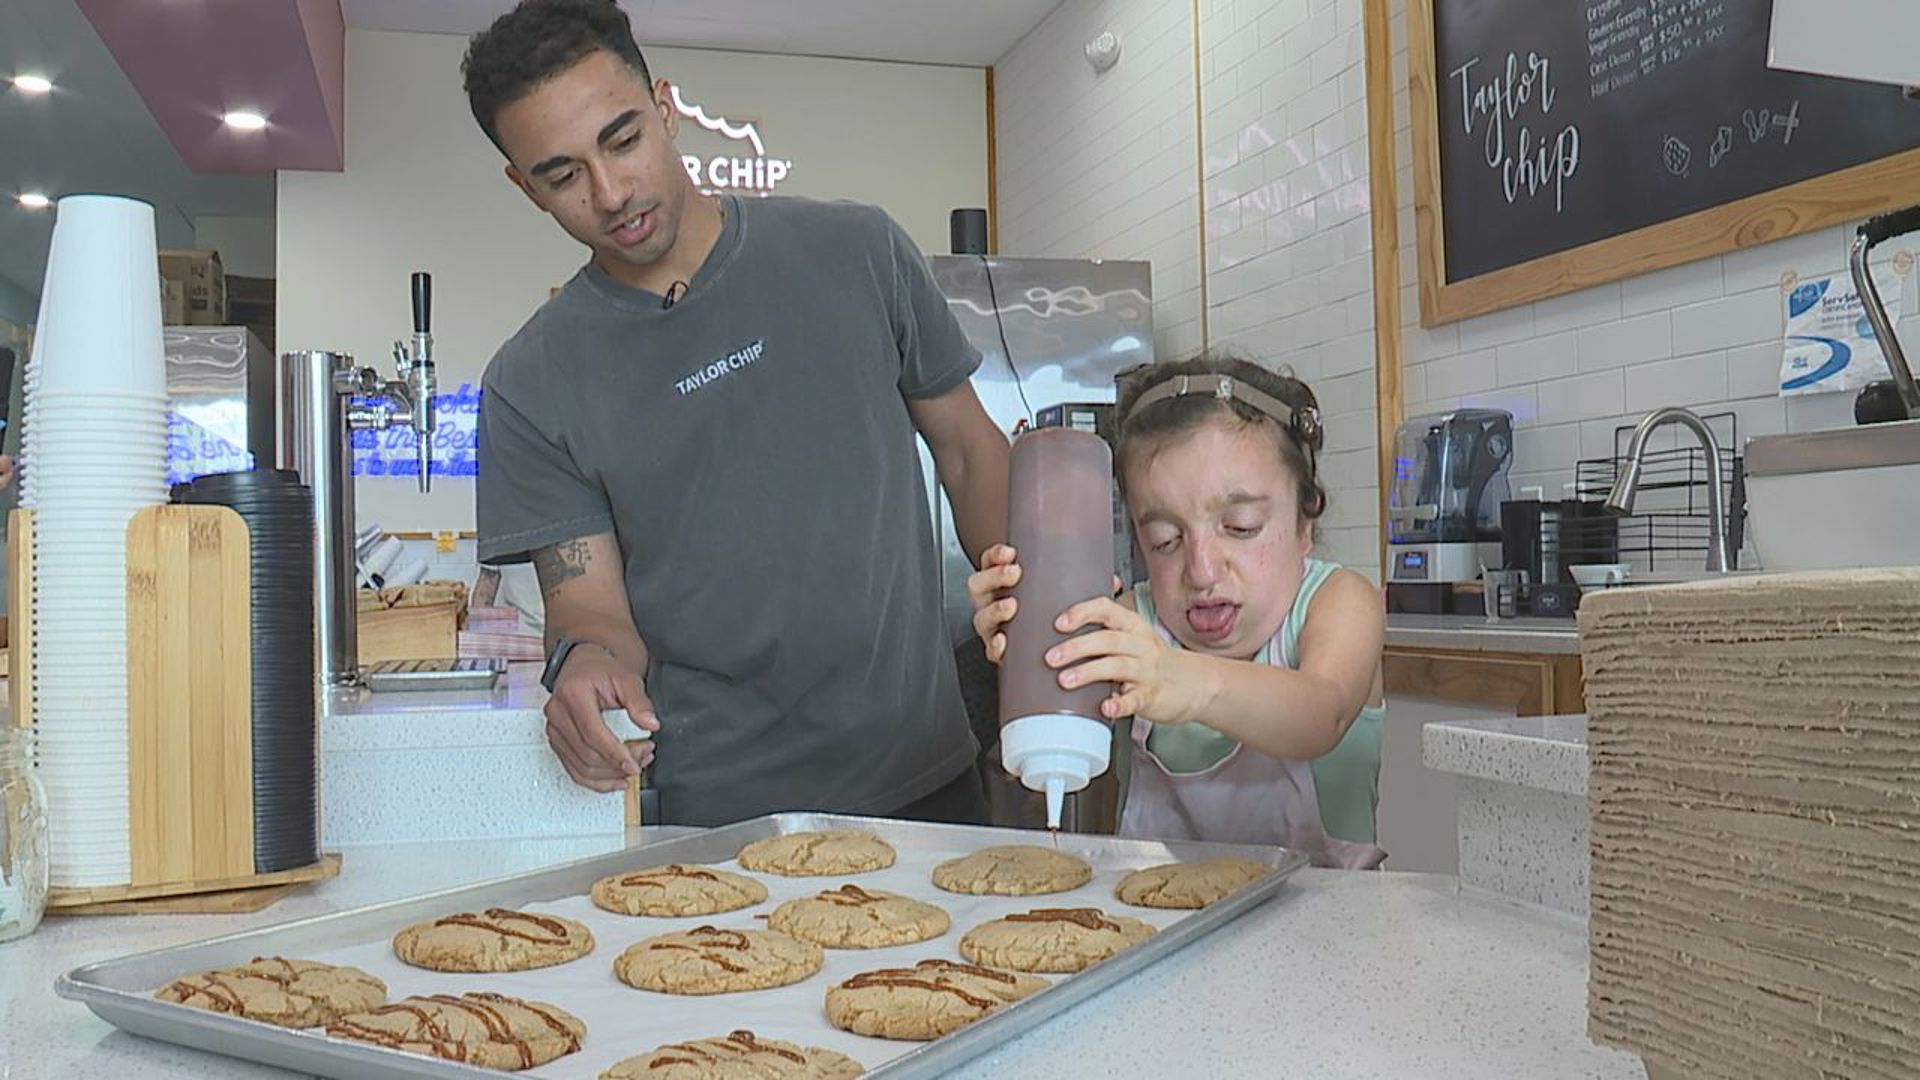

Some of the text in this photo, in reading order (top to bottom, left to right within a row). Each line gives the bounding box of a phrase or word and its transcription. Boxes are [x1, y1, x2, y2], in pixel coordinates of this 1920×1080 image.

[1704, 4, 1725, 21] TAX
[1704, 24, 1726, 42] TAX
[1450, 52, 1556, 168] Taylor
[1503, 125, 1579, 212] chip
[675, 342, 763, 396] TAYLOR CHIP
[434, 421, 479, 449] Bes
